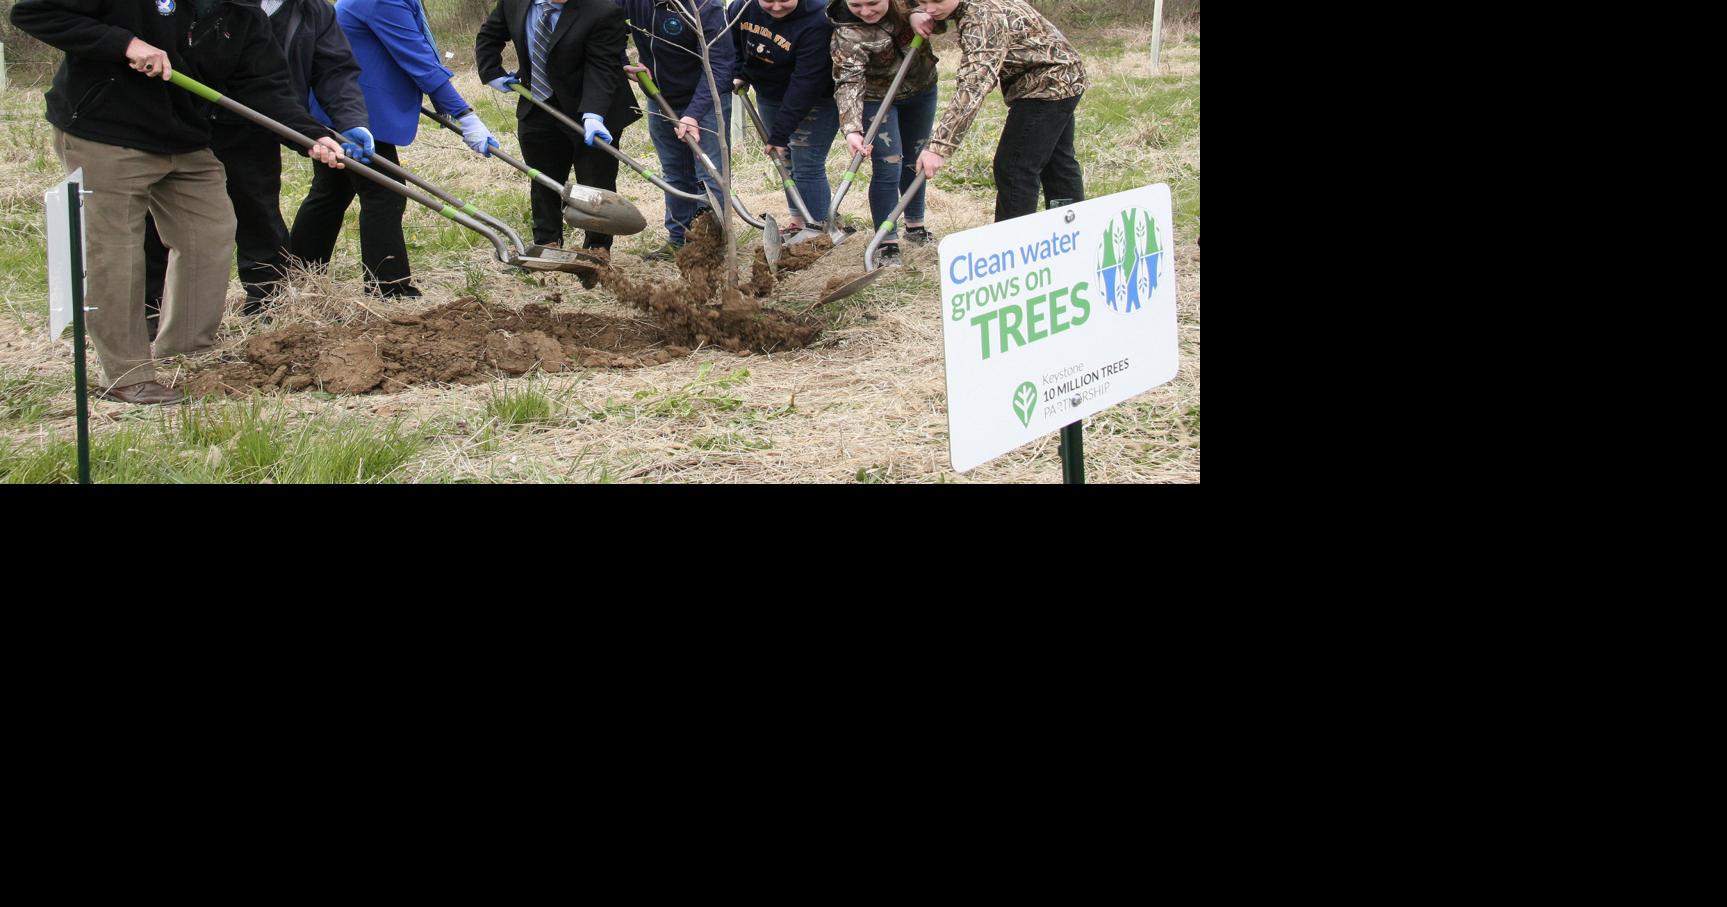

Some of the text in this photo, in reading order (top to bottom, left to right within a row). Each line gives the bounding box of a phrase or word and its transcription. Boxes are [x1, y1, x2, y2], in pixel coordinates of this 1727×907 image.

[950, 231, 1080, 285] Clean water
[951, 267, 1051, 322] grows on
[970, 282, 1092, 361] TREES
[1042, 362, 1085, 386] Keystone
[1043, 358, 1130, 403] 10 MILLION TREES
[1044, 381, 1111, 420] PARTRSHIP
